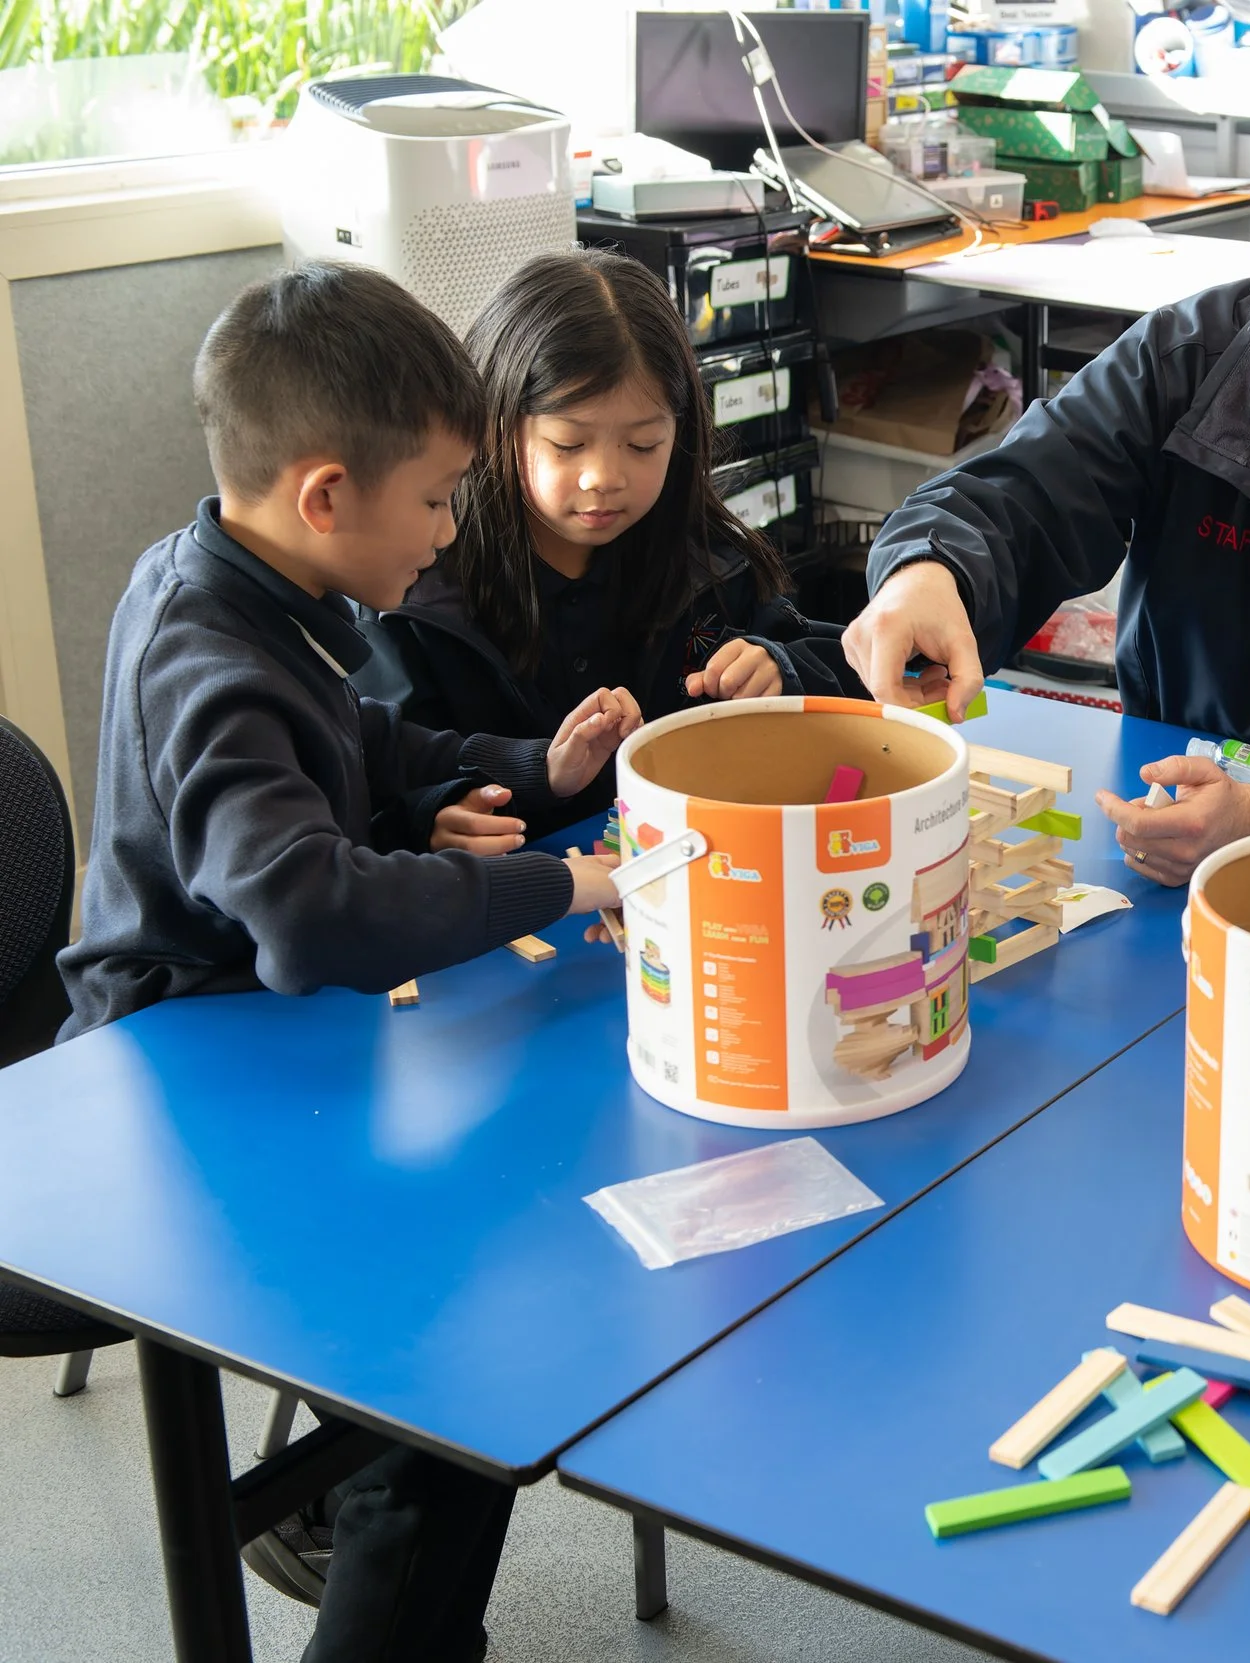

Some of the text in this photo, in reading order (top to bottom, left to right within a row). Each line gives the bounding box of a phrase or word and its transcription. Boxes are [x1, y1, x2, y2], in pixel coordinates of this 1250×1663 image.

[717, 278, 740, 292] Tubes
[720, 395, 743, 410] Tubes
[852, 840, 878, 853] VIGA
[730, 868, 759, 881] VIGA
